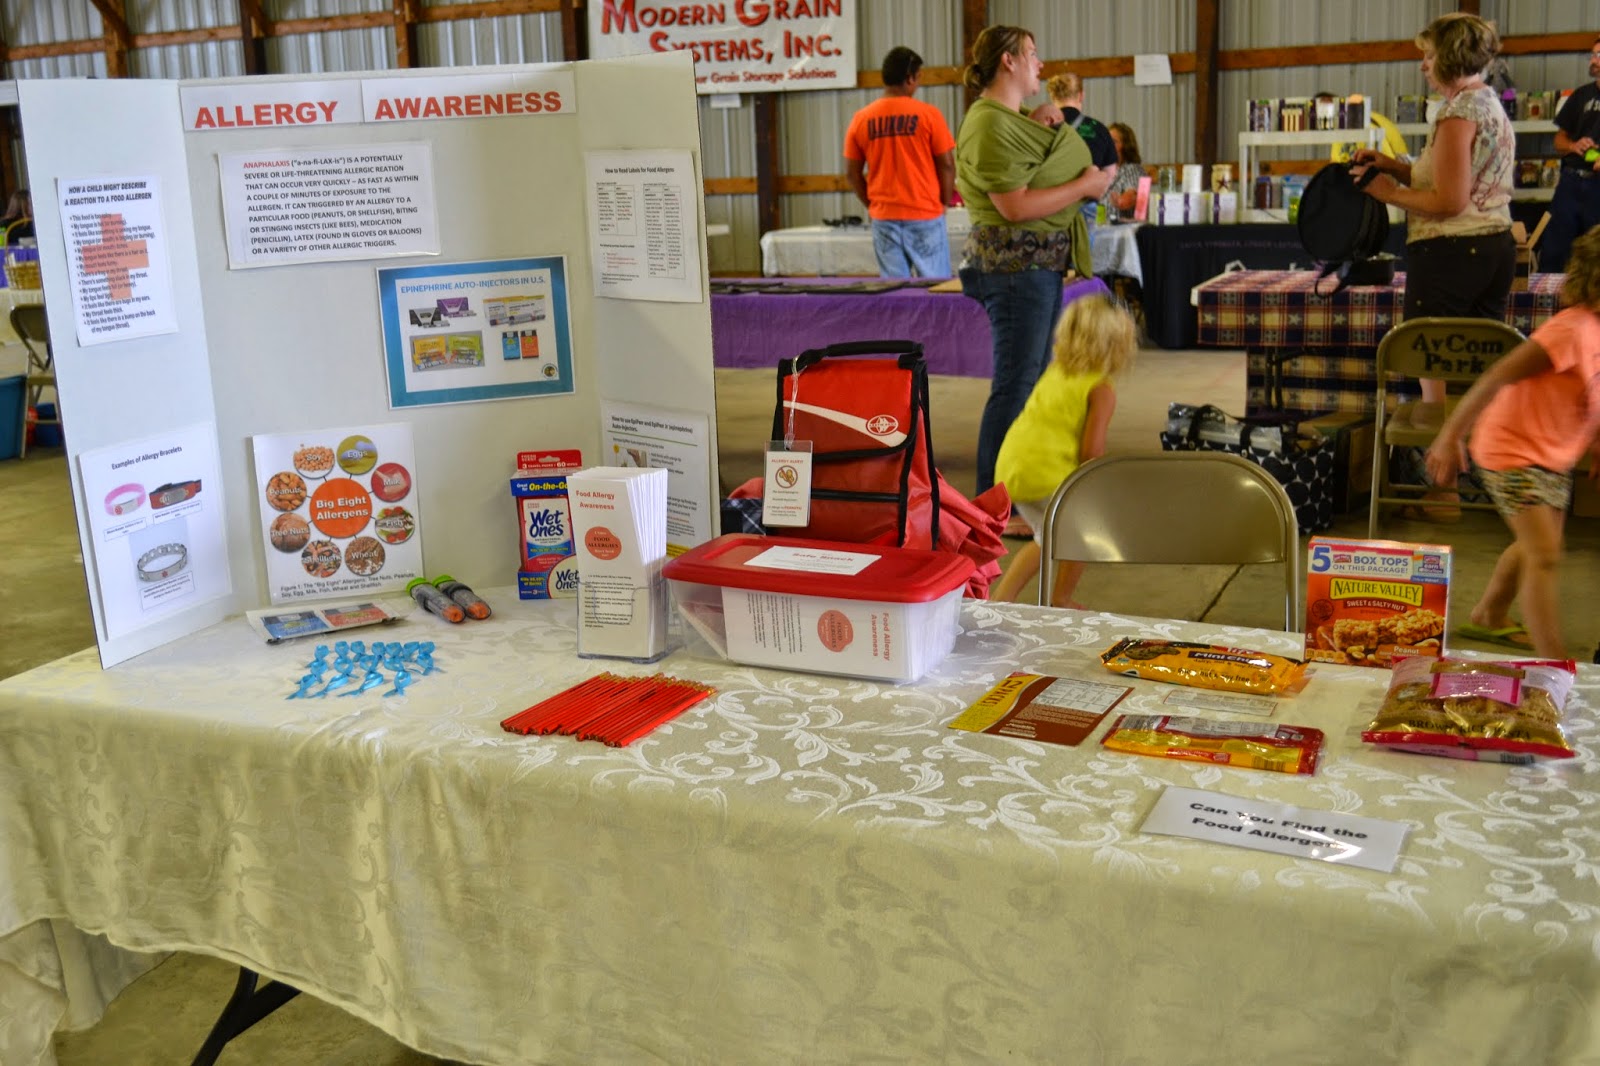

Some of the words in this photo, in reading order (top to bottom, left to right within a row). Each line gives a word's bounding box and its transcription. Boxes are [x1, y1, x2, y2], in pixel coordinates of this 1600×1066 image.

[783, 30, 842, 58] INC.
[711, 71, 740, 83] Grain
[743, 71, 784, 84] Storage
[788, 68, 837, 80] Solutions
[194, 100, 338, 129] ALLERGY
[374, 91, 562, 120] AWARENESS
[243, 160, 290, 169] ANAPHALAXIS
[291, 157, 346, 167] ("a-na-fi-LAX-is")
[360, 155, 403, 163] POTENTIALLY
[244, 172, 269, 180] SEVERE
[281, 168, 343, 177] LIFE-THREATENING
[344, 166, 374, 175] ALLERGIC
[68, 186, 81, 194] HOW
[87, 185, 102, 193] CHILD
[103, 183, 120, 191] MIGHT
[121, 182, 147, 190] DESCRIBE
[332, 188, 367, 196] EXPOSURE
[70, 197, 97, 205] REACTION
[125, 192, 152, 201] ALLERGEN
[307, 200, 344, 208] TRIGGERED
[248, 214, 290, 222] PARTICULAR
[311, 211, 346, 220] (PEANUTS,
[357, 208, 395, 216] SHELLFISH),
[395, 206, 418, 214] BITING
[322, 222, 338, 230] (LIKE
[251, 236, 293, 245] (PENICILLIN),
[315, 232, 342, 241] (FOUND
[351, 230, 377, 238] GLOVES
[388, 227, 422, 235] BALOONS)
[308, 243, 331, 251] OTHER
[400, 283, 453, 294] EPINEPHRINE
[454, 279, 520, 289] AUTO-INJECTORS
[530, 276, 546, 284] U.S.
[1424, 352, 1486, 374] Park
[111, 459, 135, 470] Examples
[135, 455, 141, 463] of
[141, 452, 159, 461] Allergy
[159, 446, 183, 456] Bracelets
[306, 453, 322, 461] Soy
[347, 450, 368, 459] Eggs
[383, 478, 401, 486] Milk
[269, 487, 302, 495] Peanuts
[592, 492, 615, 500] Allergy
[316, 500, 334, 509] Big
[338, 496, 367, 507] Eight
[579, 502, 615, 510] Awareness
[316, 507, 368, 520] Allergens
[530, 509, 564, 526] Wet
[386, 519, 404, 527] Fish
[271, 528, 288, 537] Tree
[290, 526, 310, 535] Nuts
[529, 524, 564, 538] Ones
[351, 551, 378, 559] Wheat
[1312, 546, 1331, 572] 5
[1353, 556, 1377, 565] BOX
[1381, 557, 1409, 566] TOPS
[556, 569, 579, 581] Wet
[1367, 565, 1408, 574] PACKAGE!
[1334, 580, 1377, 597] NATURE
[1379, 583, 1420, 602] VALLEY
[1372, 600, 1391, 608] SALTY
[1391, 603, 1405, 611] NUT
[882, 612, 890, 631] Food
[883, 633, 891, 661] Allergy
[1394, 646, 1420, 654] Peanut
[1194, 652, 1226, 660] Mini
[1408, 720, 1453, 732] BROWN
[1189, 802, 1229, 816] Can
[1281, 820, 1326, 833] Find
[1332, 828, 1368, 839] the
[1191, 817, 1243, 833] Food
